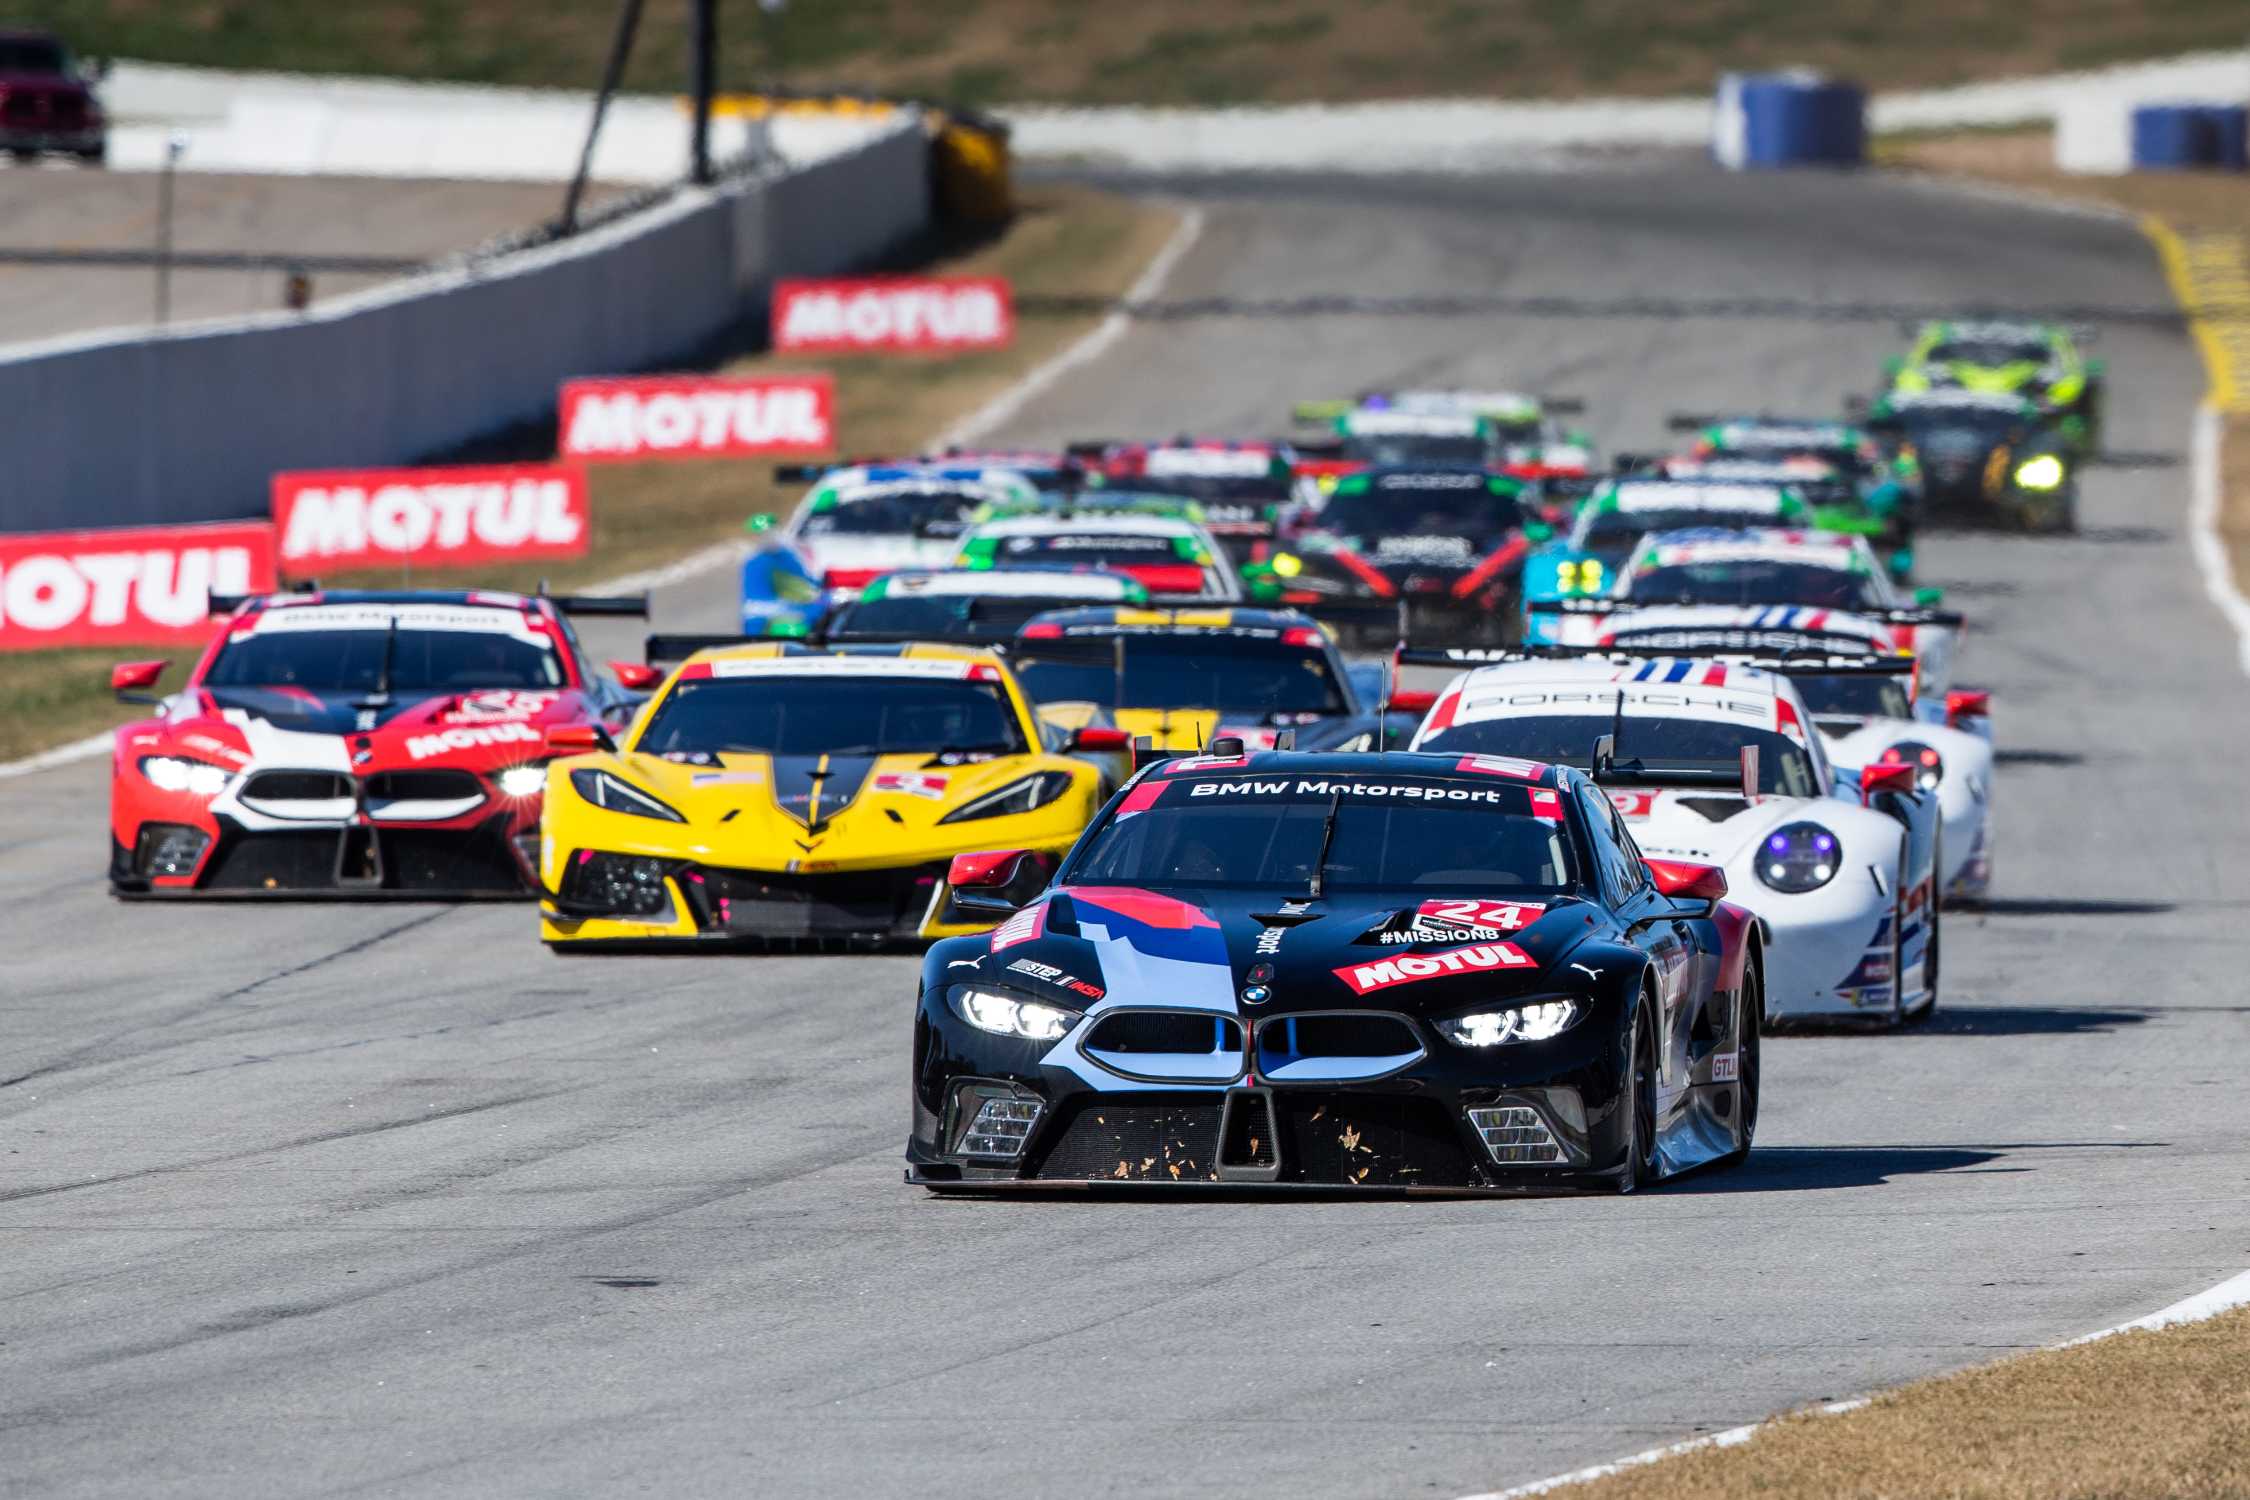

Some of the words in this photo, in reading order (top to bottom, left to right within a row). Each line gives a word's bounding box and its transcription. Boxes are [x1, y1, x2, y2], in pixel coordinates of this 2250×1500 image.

[568, 388, 828, 453] MOTUL
[281, 479, 582, 559] MOTUL
[0, 546, 250, 631] OTU
[1467, 693, 1768, 716] PORSCHE
[406, 722, 541, 760] MOTUL
[1190, 782, 1289, 797] BMW
[1296, 781, 1500, 803] Motorsport
[1434, 901, 1523, 930] 24
[1380, 929, 1500, 944] #MISSION8
[1025, 960, 1063, 978] STEP
[1353, 945, 1527, 989] MOTUL
